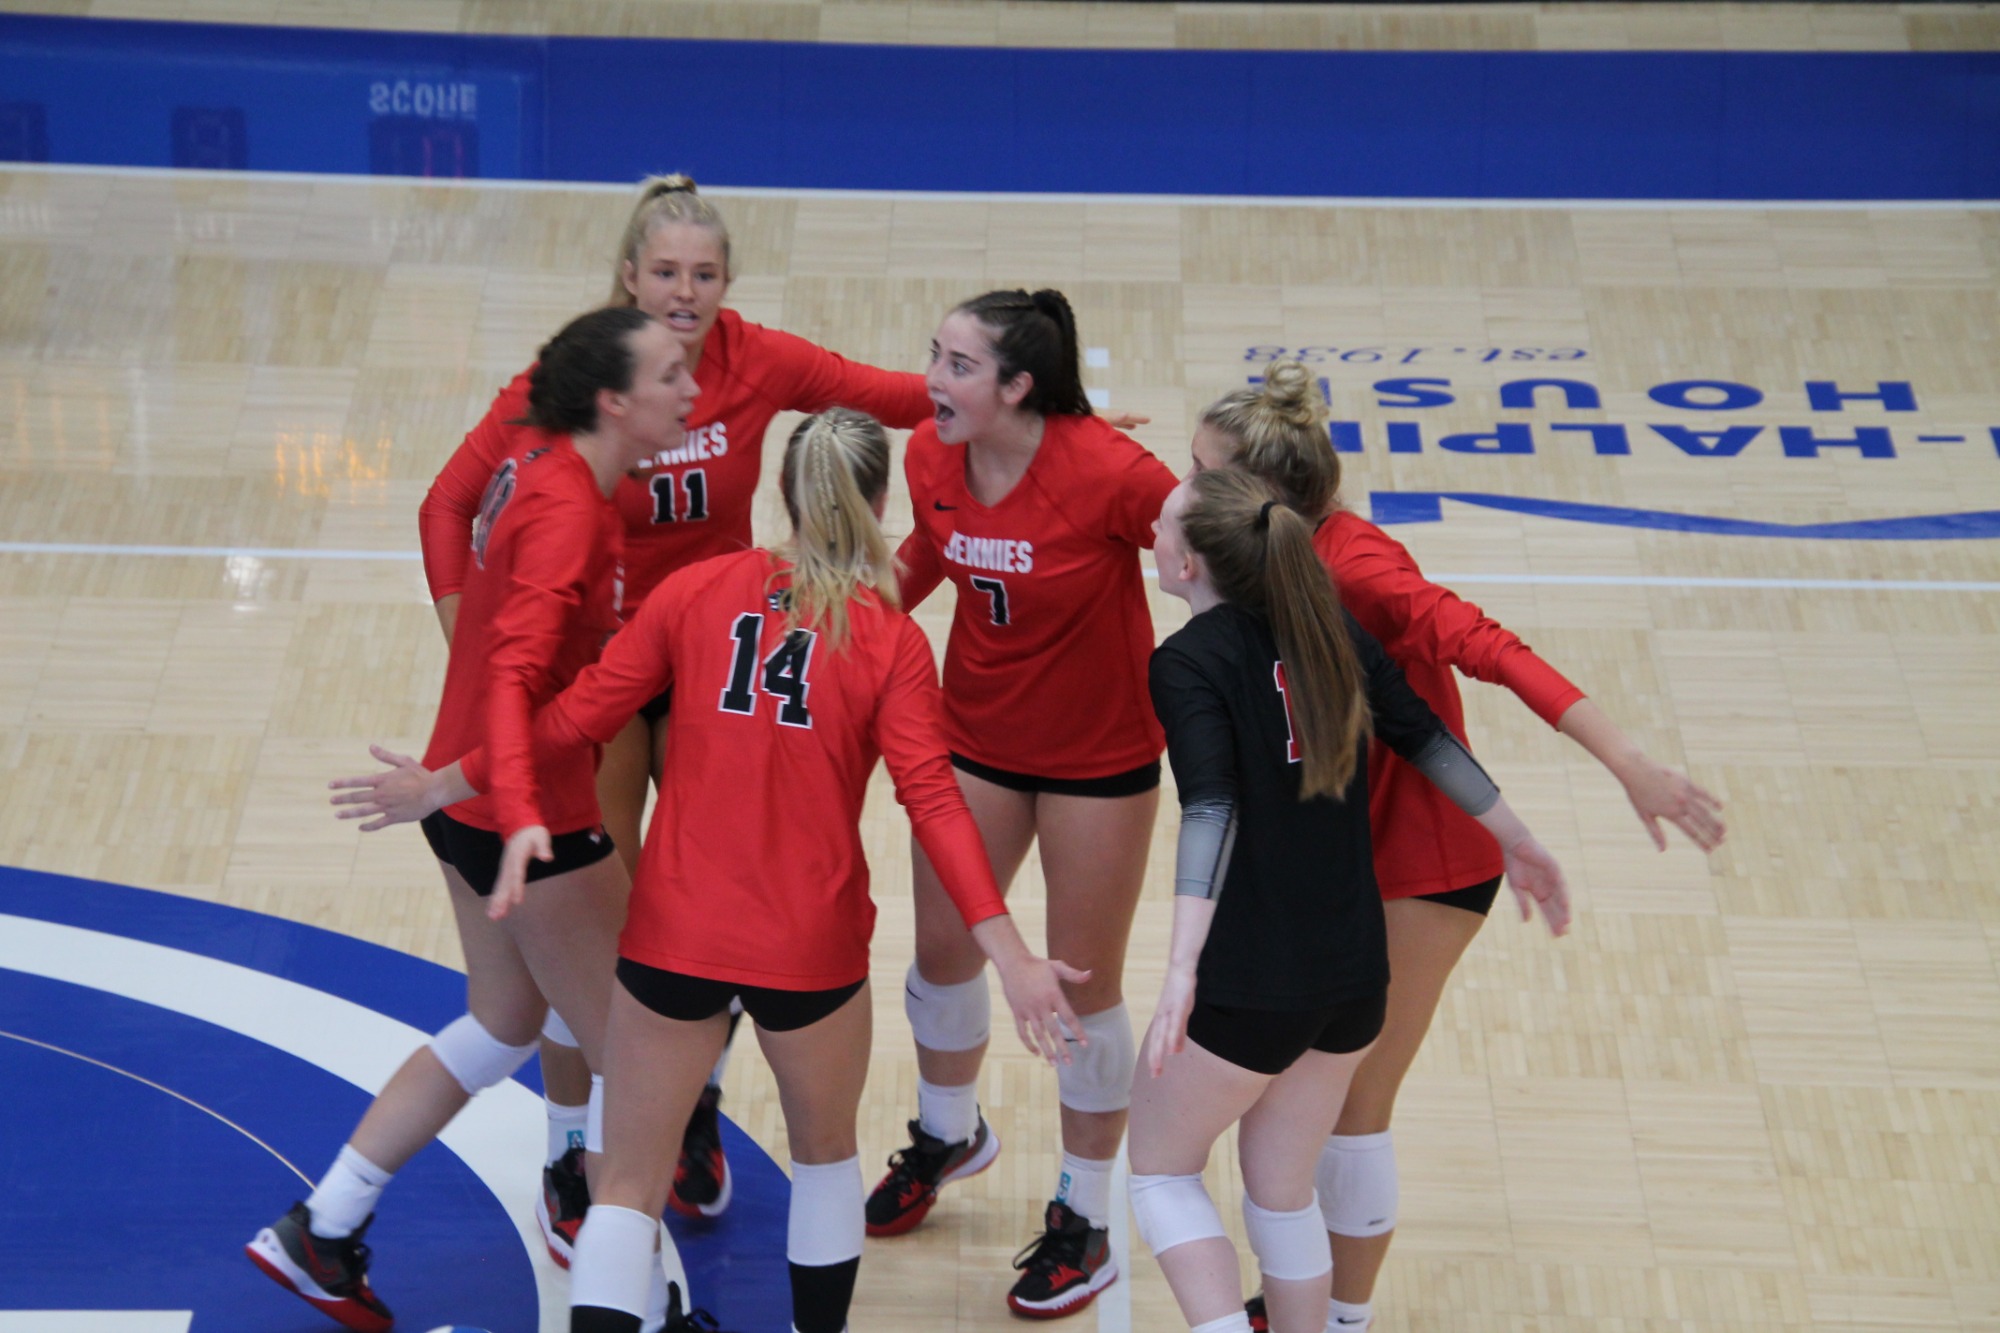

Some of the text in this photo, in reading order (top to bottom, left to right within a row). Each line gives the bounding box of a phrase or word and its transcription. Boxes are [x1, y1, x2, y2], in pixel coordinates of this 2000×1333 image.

[1328, 420, 2000, 458] -HALPI
[649, 468, 709, 525] 11
[943, 529, 1034, 574] JENNIES
[969, 574, 1012, 627] 7
[717, 611, 818, 730] 14
